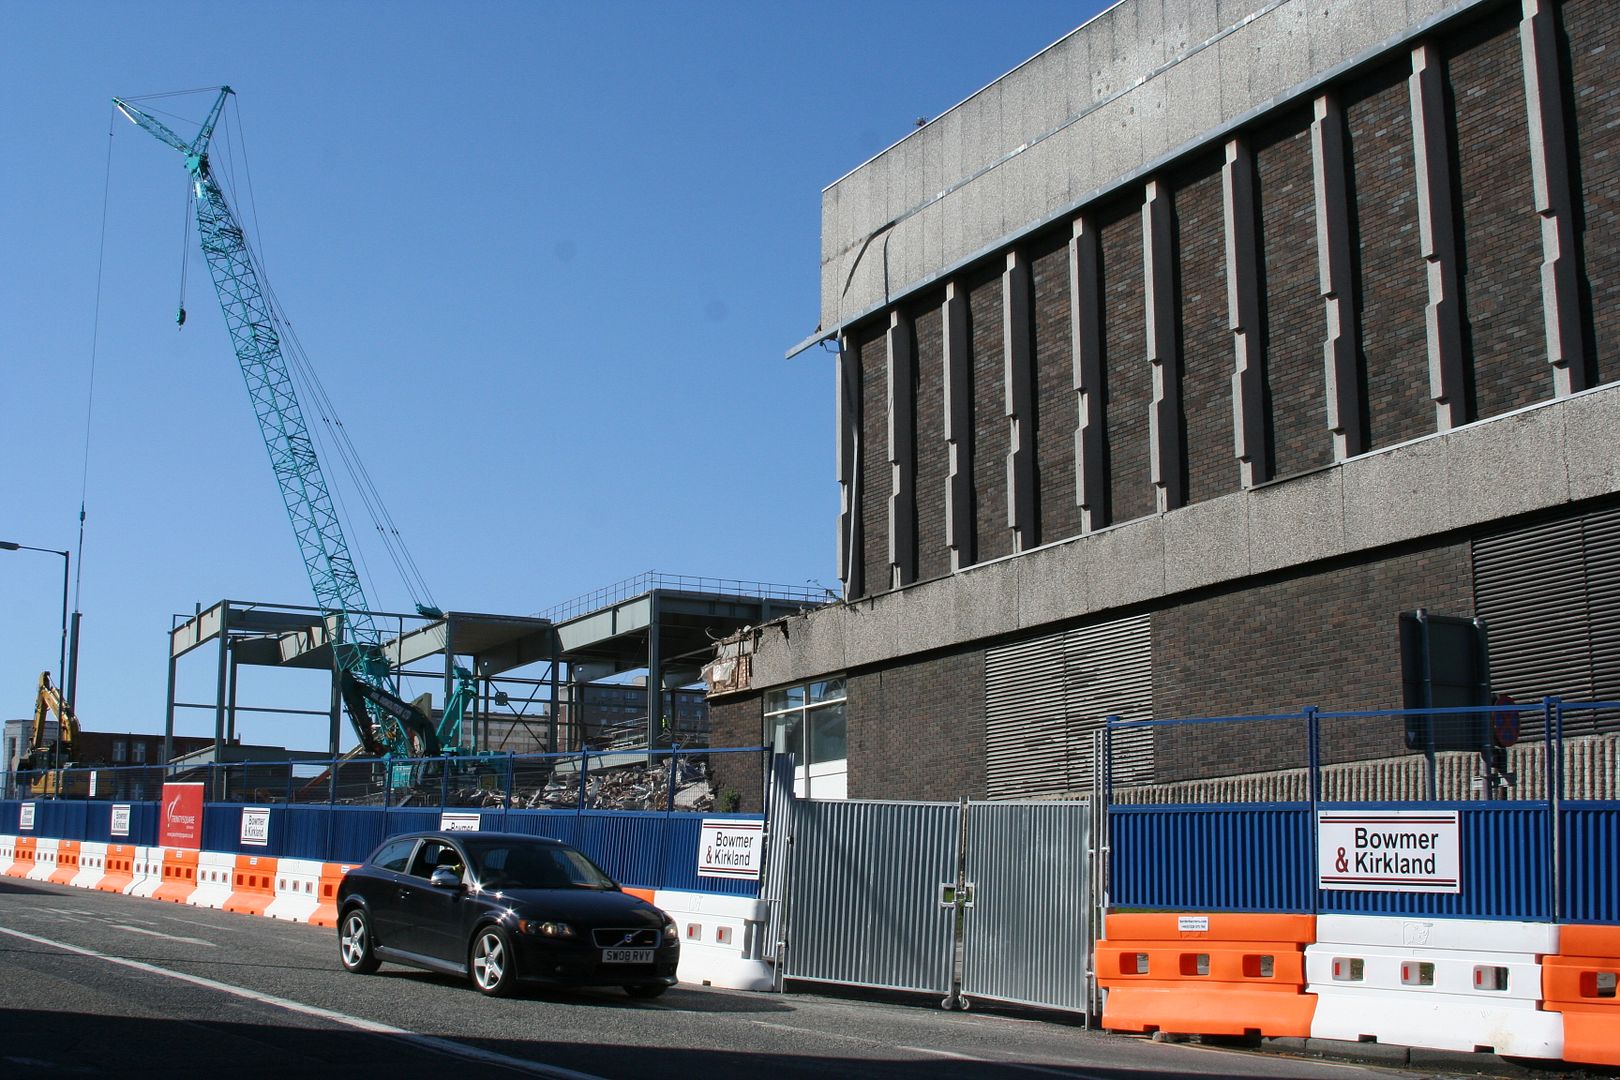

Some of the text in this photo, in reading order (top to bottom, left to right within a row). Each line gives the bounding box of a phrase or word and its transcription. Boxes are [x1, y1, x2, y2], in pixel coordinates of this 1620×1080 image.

[715, 831, 754, 848] Bowmer
[1354, 827, 1439, 850] Bowmer
[705, 845, 751, 866] & Kirkland
[1335, 846, 1436, 875] & Kirkland
[606, 950, 651, 961] SW08 RVY
